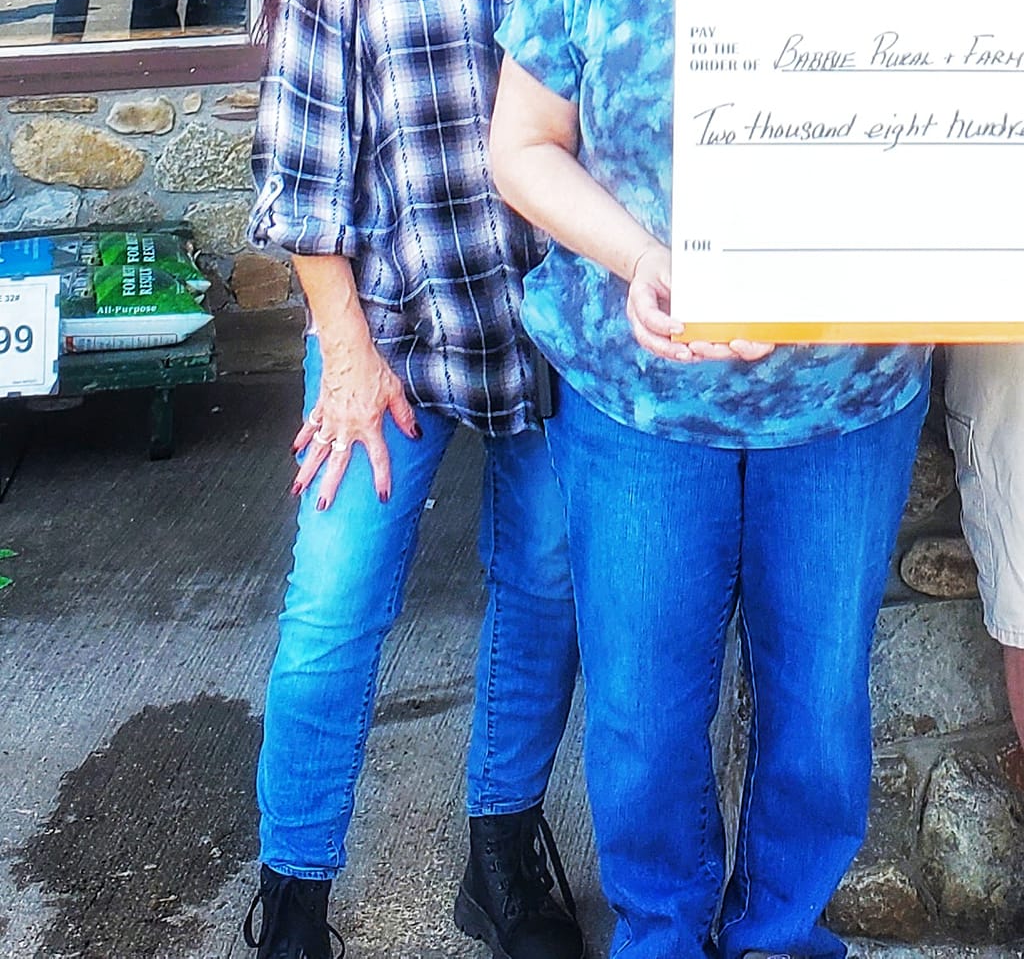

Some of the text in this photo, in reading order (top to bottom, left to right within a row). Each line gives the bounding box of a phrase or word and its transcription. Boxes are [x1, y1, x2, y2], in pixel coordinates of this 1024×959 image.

[690, 27, 716, 38] PAY
[691, 43, 738, 55] TO THE
[690, 59, 760, 71] ORDER OF
[694, 103, 737, 145] Two
[744, 110, 857, 140] thousand
[864, 113, 938, 152] eight
[684, 240, 711, 251] FOR
[97, 304, 157, 315] All-Purpose
